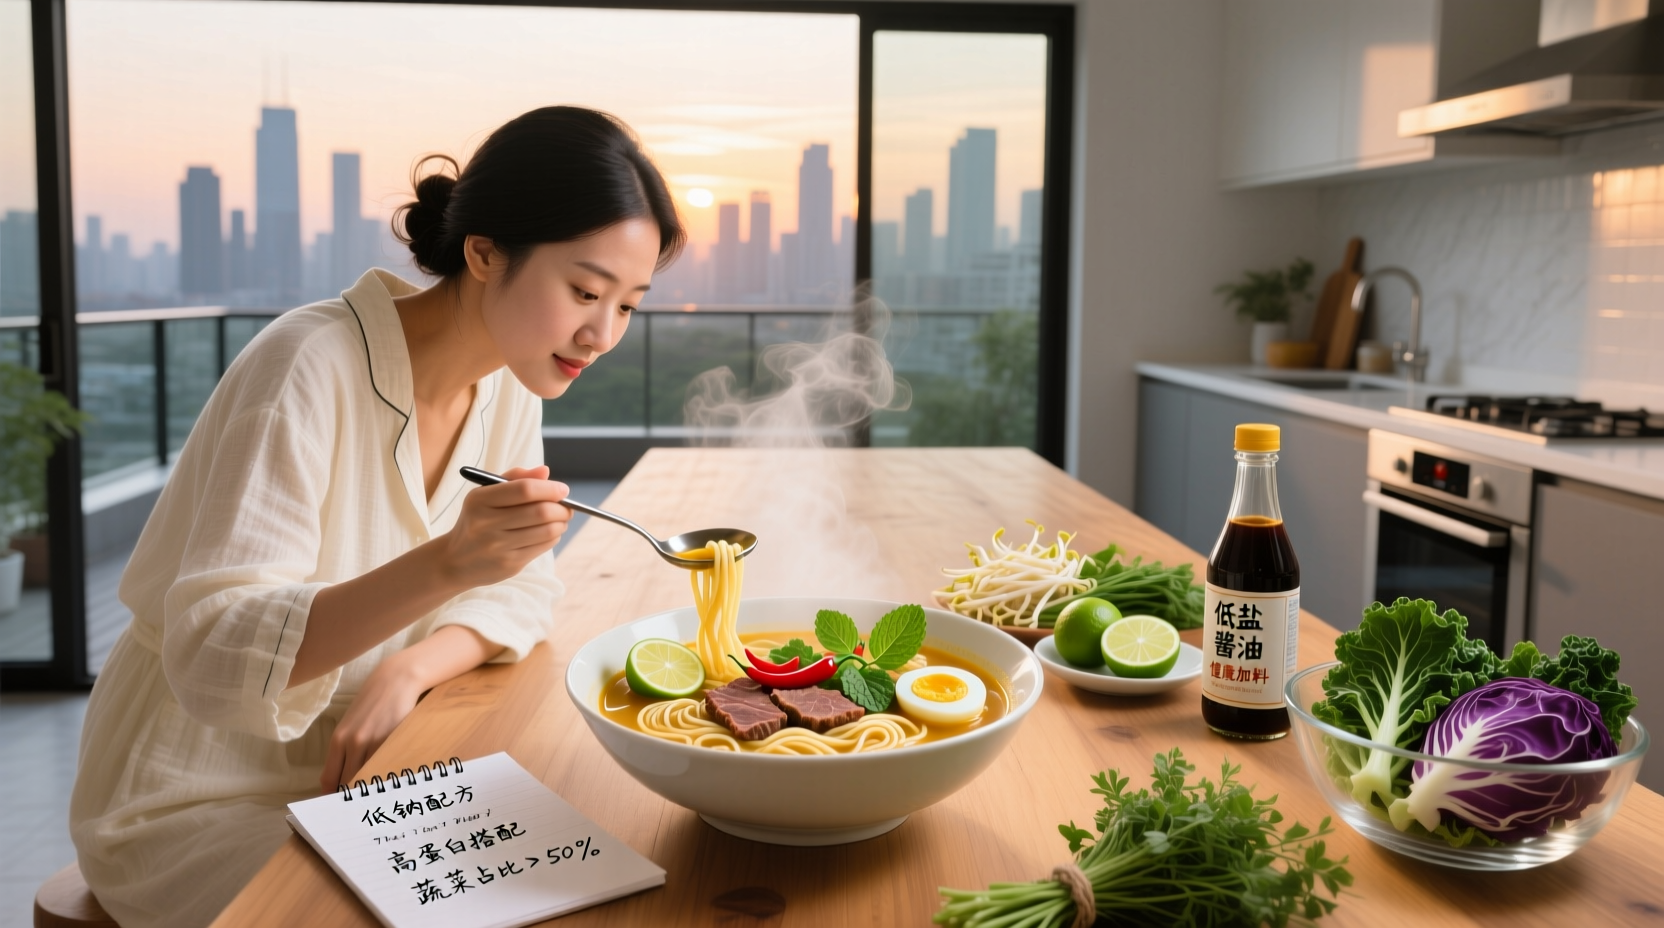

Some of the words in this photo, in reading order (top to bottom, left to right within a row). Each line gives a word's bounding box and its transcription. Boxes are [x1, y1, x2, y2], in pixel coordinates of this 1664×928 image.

[1215, 600, 1263, 630] 低盐
[361, 785, 474, 827] 低钠配方
[388, 822, 526, 874] 高蛋白搭配
